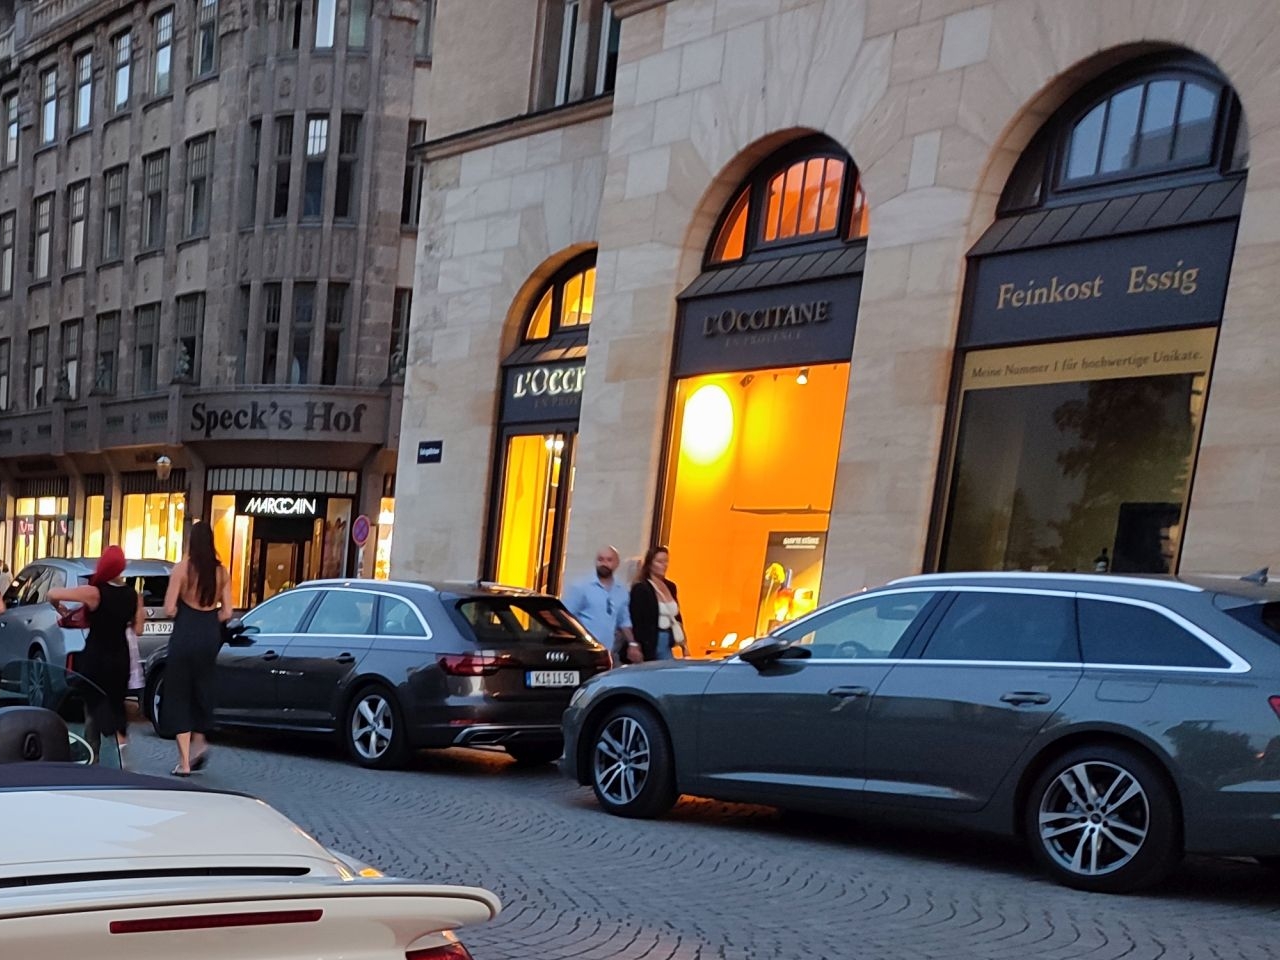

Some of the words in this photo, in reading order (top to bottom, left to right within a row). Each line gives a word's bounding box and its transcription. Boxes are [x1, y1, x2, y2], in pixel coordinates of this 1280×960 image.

[996, 274, 1104, 310] Feinkost
[1127, 259, 1200, 296] Essig
[703, 300, 830, 336] L'OCCITANE
[972, 367, 1002, 378] Meine
[1005, 363, 1050, 376] Nummer
[1063, 357, 1078, 371] für
[1081, 355, 1149, 369] hochwertige
[1153, 349, 1203, 363] Unikate.
[191, 401, 293, 438] Speck's
[305, 401, 367, 433] Hof
